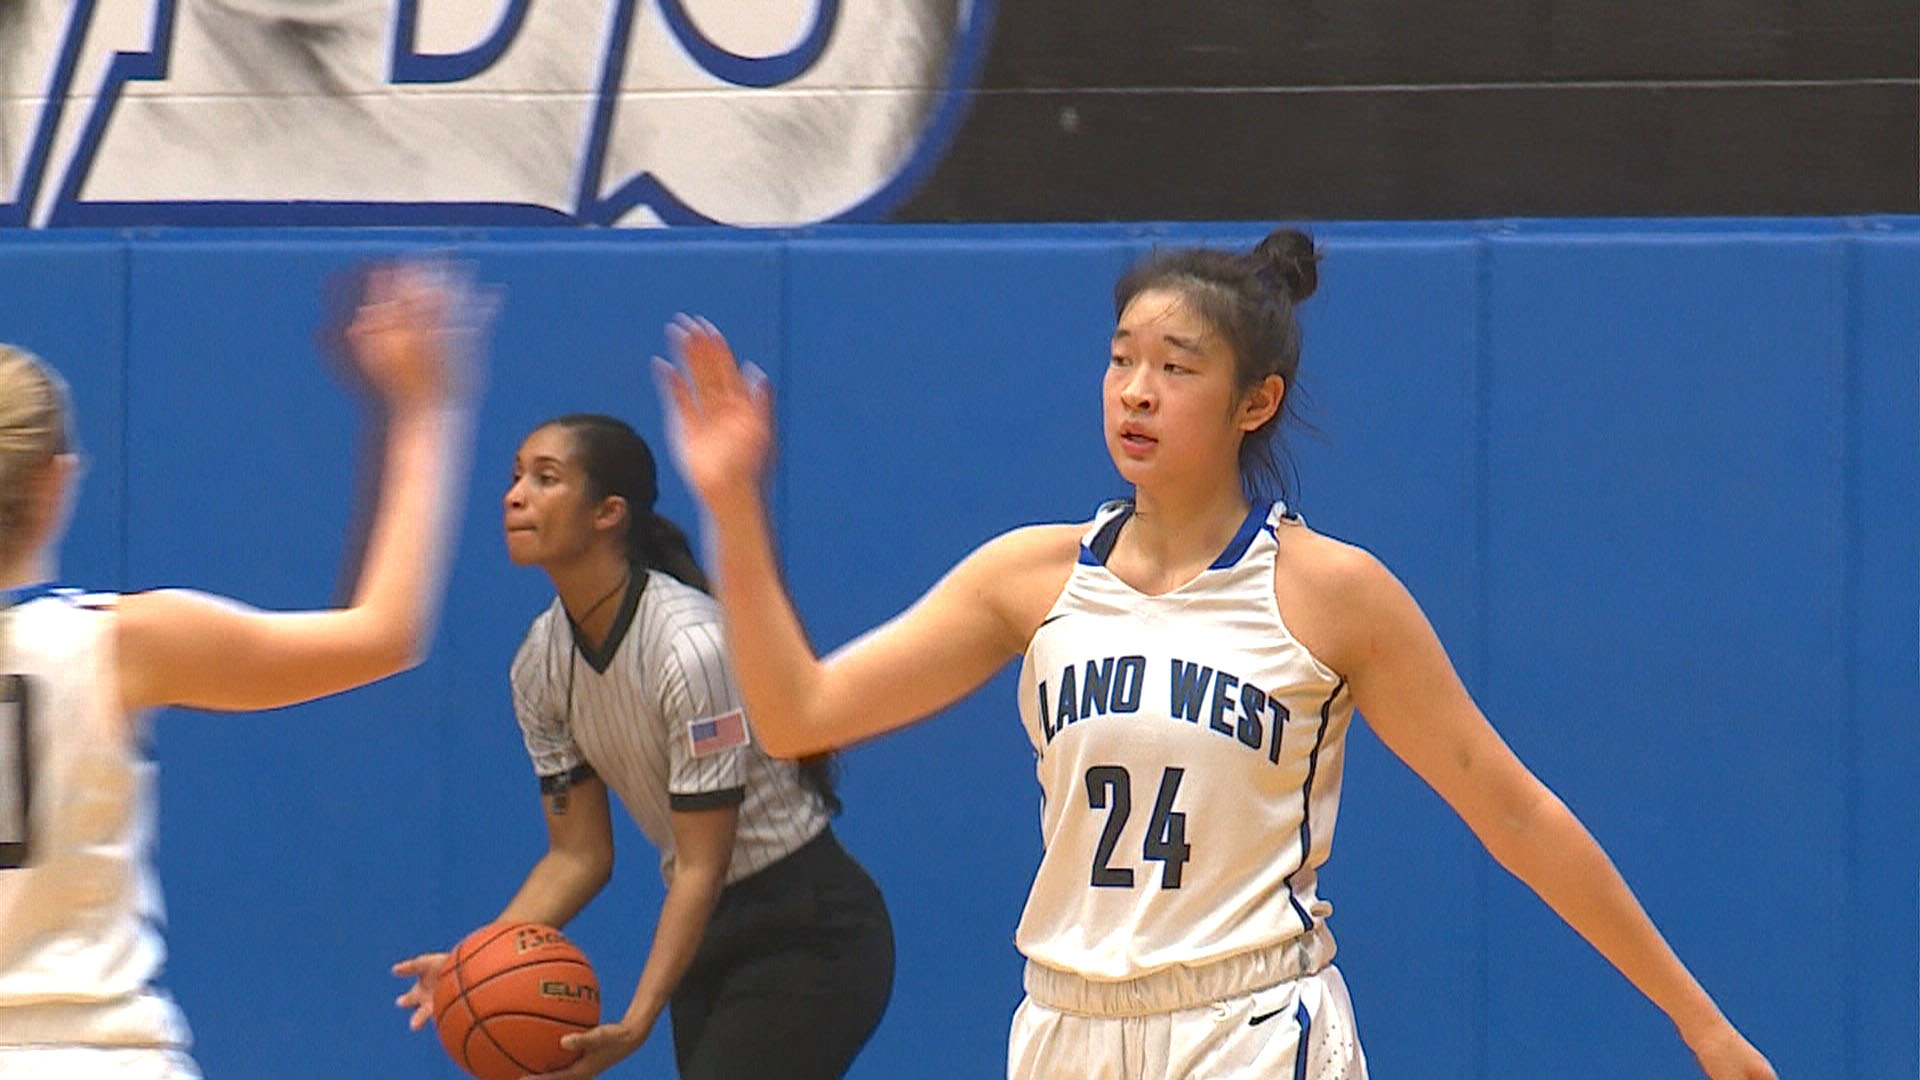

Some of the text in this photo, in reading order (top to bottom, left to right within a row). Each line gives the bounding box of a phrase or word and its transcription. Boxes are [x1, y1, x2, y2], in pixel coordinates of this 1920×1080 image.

[1038, 655, 1290, 765] LANO WEST
[1085, 765, 1191, 889] 24
[542, 981, 600, 1003] ELIT
